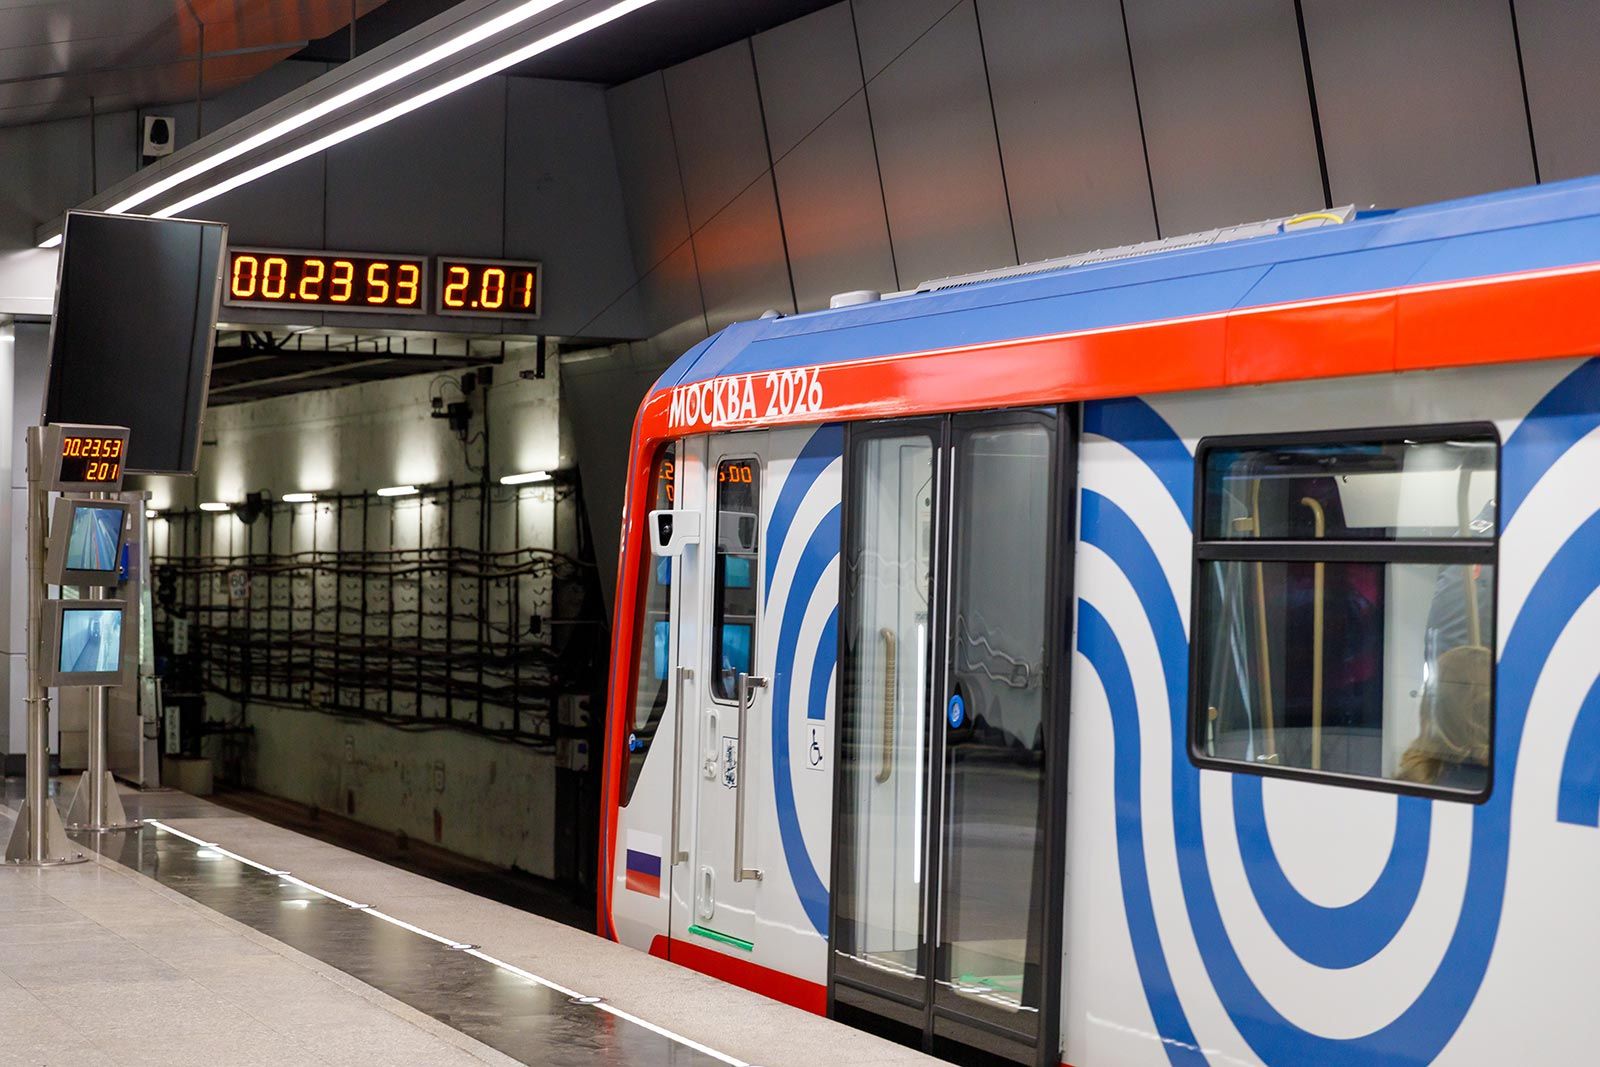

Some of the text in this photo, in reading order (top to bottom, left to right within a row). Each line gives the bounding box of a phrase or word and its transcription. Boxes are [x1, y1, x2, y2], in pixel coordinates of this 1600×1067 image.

[444, 266, 532, 308] 2.01
[668, 367, 823, 428] МОСКВА 2026
[86, 462, 118, 481] 2.01
